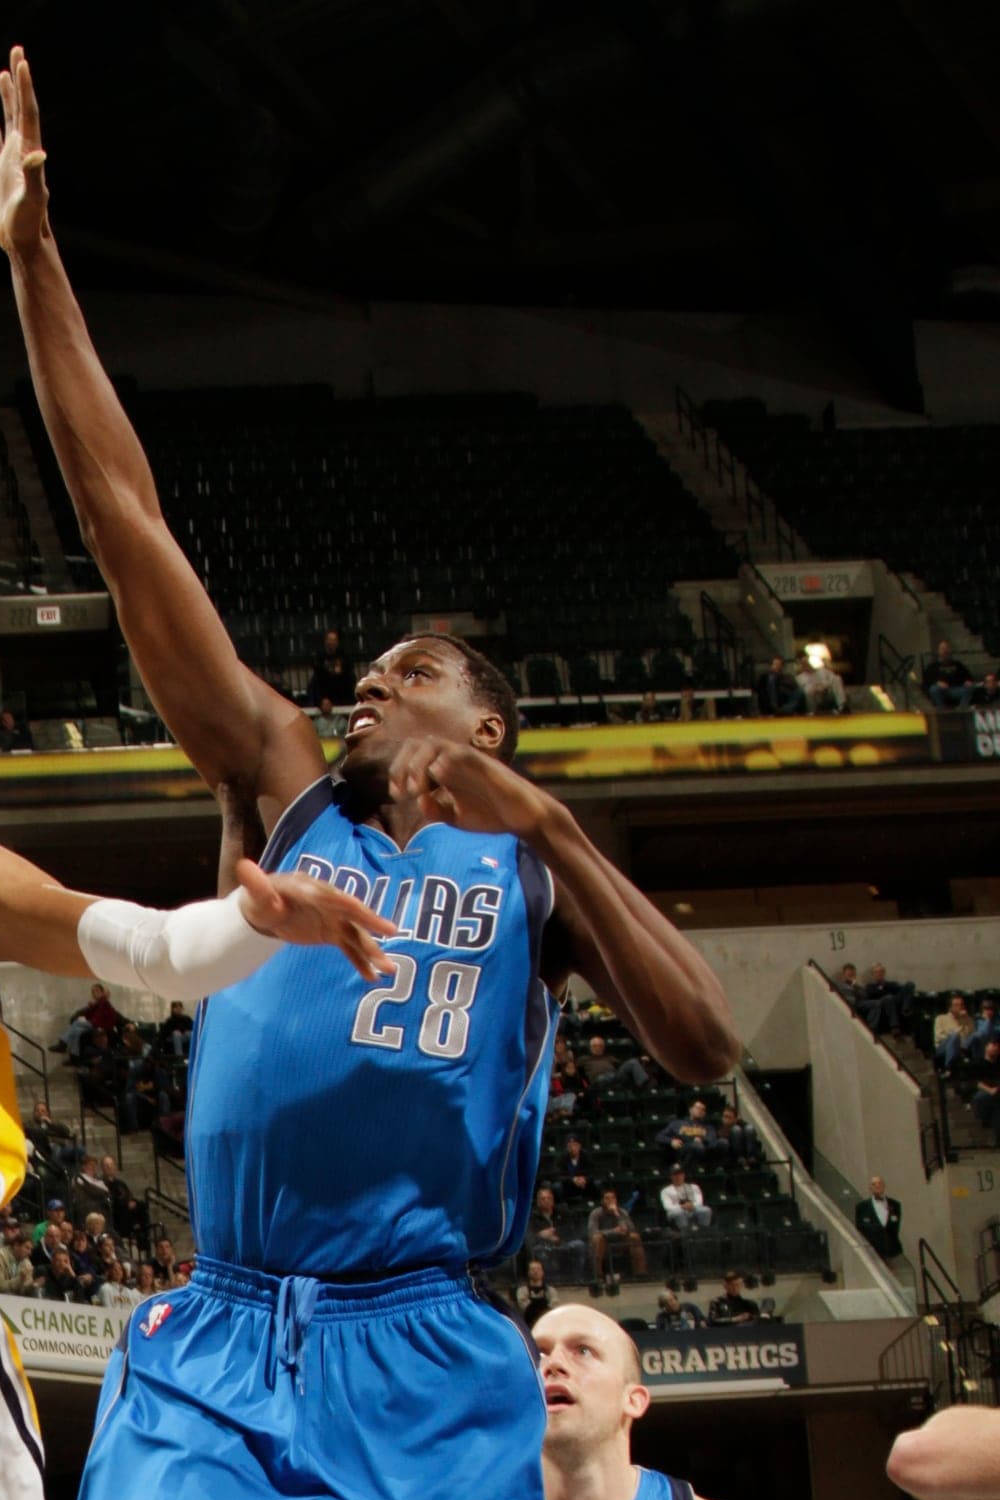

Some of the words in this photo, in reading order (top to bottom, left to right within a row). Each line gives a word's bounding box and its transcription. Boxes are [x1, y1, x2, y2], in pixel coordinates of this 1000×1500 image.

[830, 930, 846, 951] 19
[349, 953, 483, 1061] 28
[976, 1169, 995, 1193] 19
[21, 1307, 98, 1338] CHANGE
[102, 1317, 115, 1339] A
[642, 1342, 800, 1376] GRAPHICS
